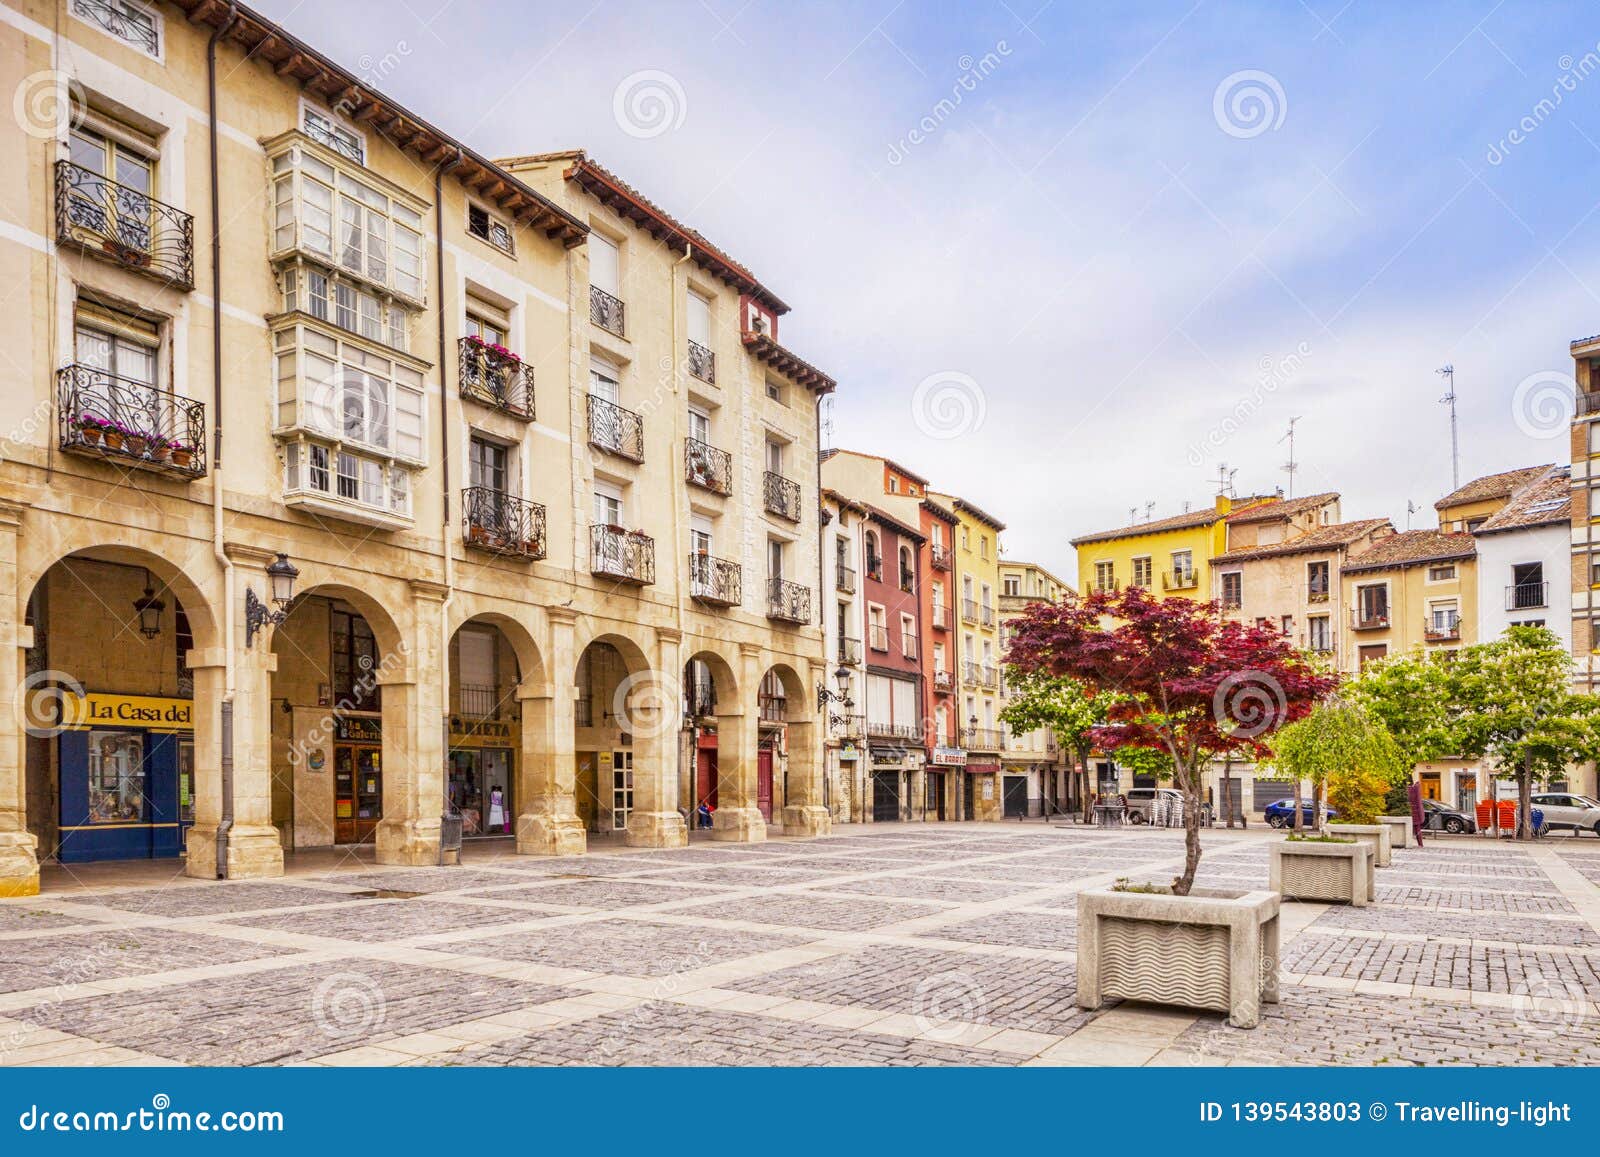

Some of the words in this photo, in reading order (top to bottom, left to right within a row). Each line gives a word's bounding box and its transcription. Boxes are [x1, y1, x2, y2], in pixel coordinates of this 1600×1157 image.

[90, 701, 114, 719] La
[117, 702, 162, 721] Casa
[165, 705, 191, 723] del
